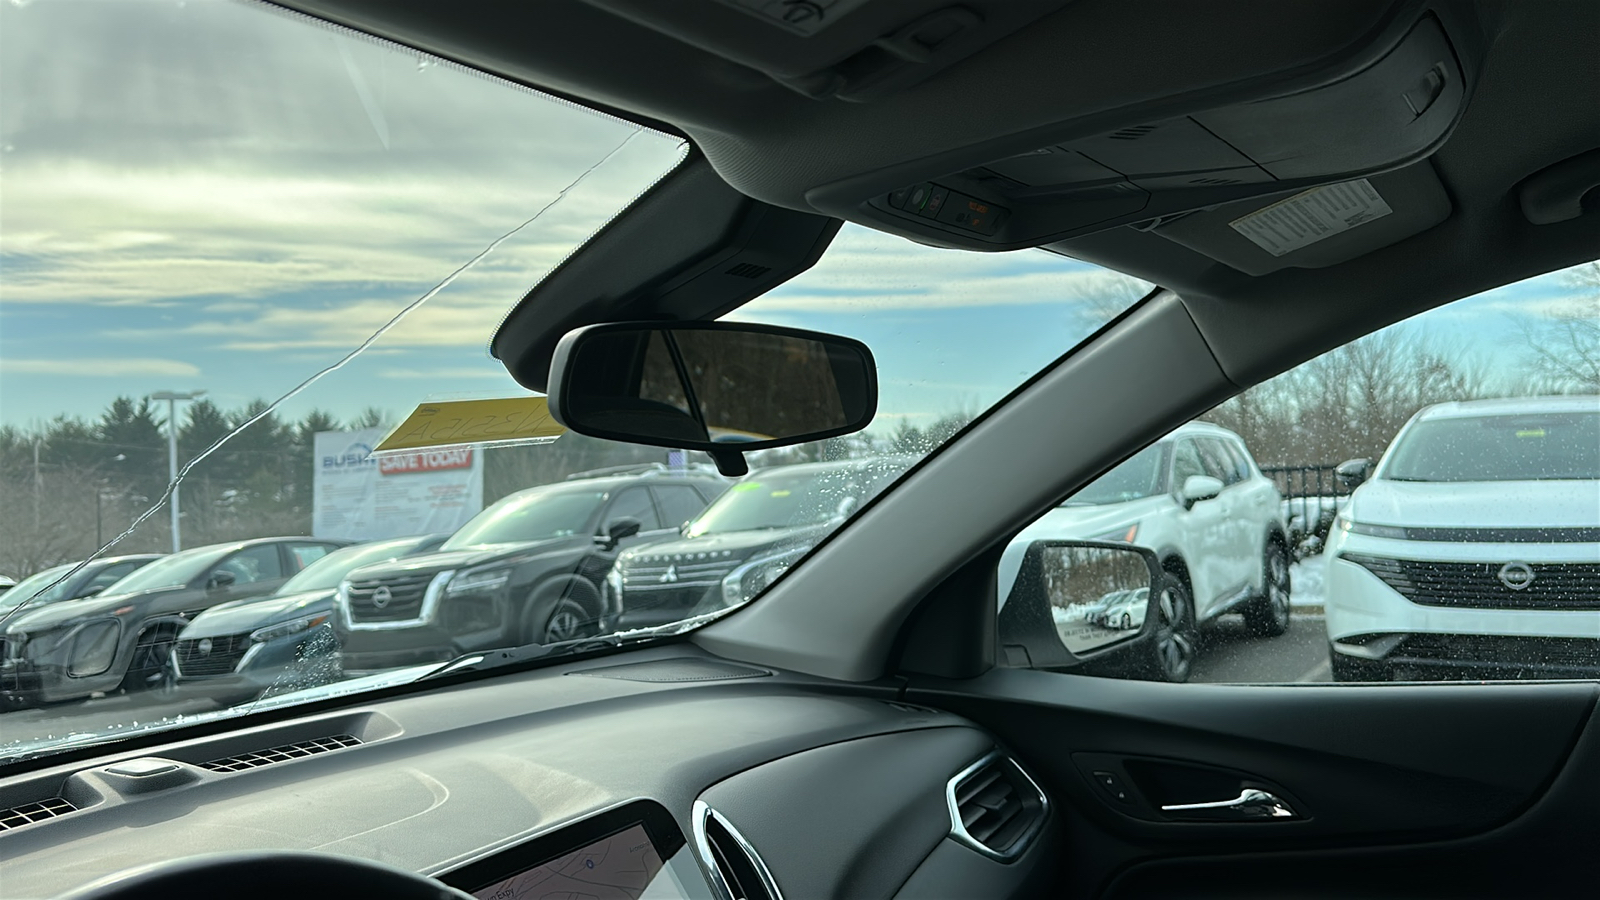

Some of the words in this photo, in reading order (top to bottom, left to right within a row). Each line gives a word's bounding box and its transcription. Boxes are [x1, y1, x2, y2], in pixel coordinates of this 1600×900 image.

[381, 453, 419, 471] SAVE
[421, 449, 469, 468] TODAY
[496, 888, 514, 900] Expy
